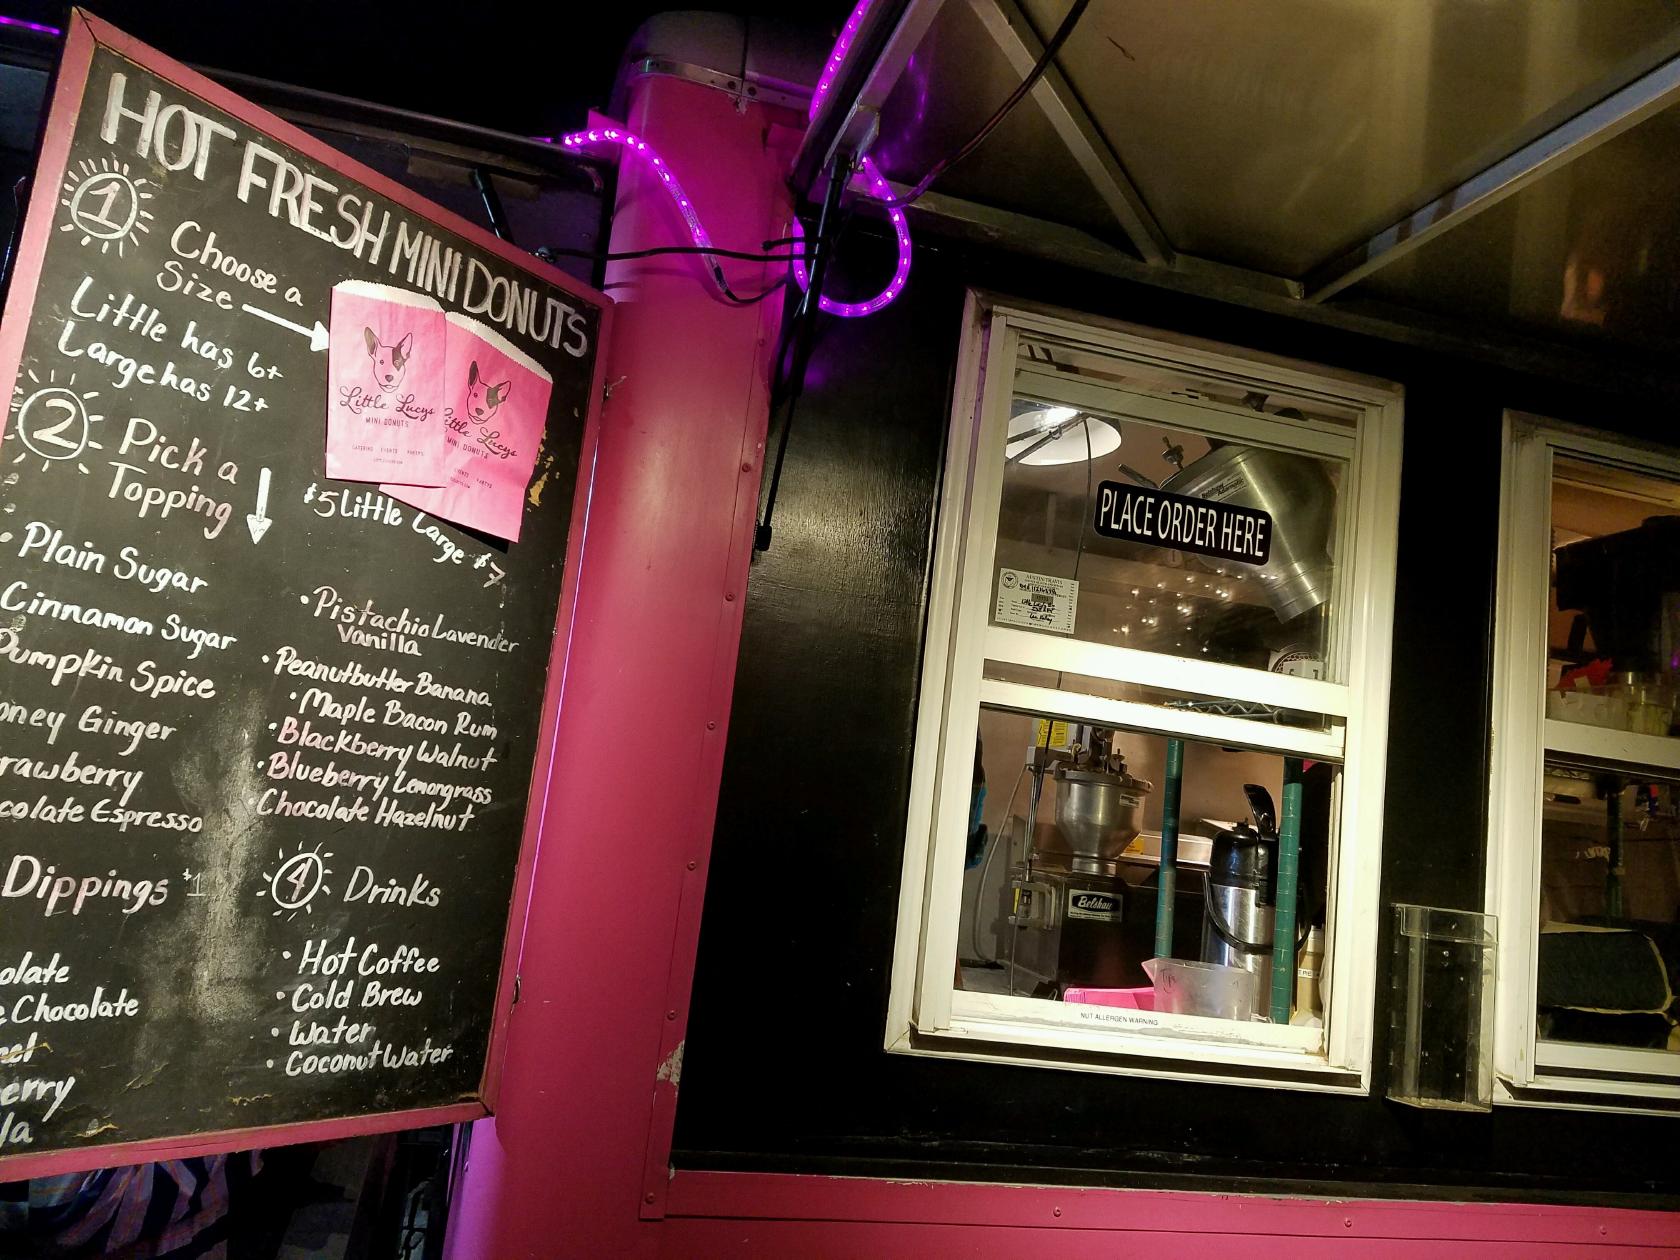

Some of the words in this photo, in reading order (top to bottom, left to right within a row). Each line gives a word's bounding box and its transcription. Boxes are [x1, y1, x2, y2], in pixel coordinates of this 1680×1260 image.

[78, 181, 122, 230] 1
[100, 72, 237, 181] HOT
[237, 140, 390, 265] FRESH
[388, 221, 463, 302] MINI
[462, 257, 588, 358] DONUTS
[156, 260, 233, 310] Size
[170, 220, 278, 294] Choose
[284, 286, 304, 307] a
[70, 276, 167, 342] Little
[181, 321, 233, 369] has
[247, 352, 284, 380] 6+
[57, 320, 155, 389] Large
[159, 361, 211, 402] has
[223, 385, 270, 412] 12+
[33, 399, 80, 449] 2
[339, 386, 389, 414] Little
[395, 394, 435, 421] Lucys
[365, 417, 381, 425] MINI
[383, 418, 409, 428] DONUTS
[119, 418, 208, 476] Pick
[217, 461, 239, 484] a
[447, 436, 460, 449] MINI
[462, 443, 489, 460] DONUTS
[477, 426, 517, 459] Lucys
[108, 462, 232, 539] Topping
[304, 483, 339, 517] $5
[340, 489, 403, 526] Little
[412, 512, 464, 563] Large
[1100, 488, 1155, 536] PLACE
[1158, 500, 1217, 548] ORDER
[1220, 512, 1266, 557] HERE
[18, 521, 105, 574] Plain
[114, 546, 208, 593] Sugar
[0, 580, 153, 636] Cinnamon
[161, 613, 237, 660] Sugar
[313, 585, 430, 639] Pistachio
[431, 613, 519, 653] Lavender
[337, 624, 422, 657] Vanilla
[129, 660, 216, 698] Spice
[414, 672, 492, 707] Banana
[78, 705, 177, 756] Ginger
[298, 687, 376, 726] Maple
[382, 700, 448, 735] Bacon
[454, 711, 497, 740] Rum
[277, 716, 414, 777] Blackberry
[416, 740, 498, 771] Walnut
[267, 751, 389, 801] Blueberry
[392, 771, 492, 811] Lemongrass
[90, 798, 203, 832] Espresso
[256, 788, 369, 822] Chocolate
[374, 796, 475, 831] Hazelnut
[1, 855, 169, 917] Dippings
[286, 857, 313, 902] 4
[343, 865, 441, 907] Drinks
[298, 936, 357, 976] Hot
[358, 943, 441, 976] Coffee
[11, 986, 139, 1023] Chocolate
[291, 979, 354, 1013] Cold
[361, 980, 423, 1007] Brew
[1095, 1013, 1128, 1023] ALLERGEN
[1128, 1016, 1159, 1026] WARNING
[289, 1015, 376, 1046] Water
[285, 1040, 382, 1077] Coconut
[383, 1038, 453, 1069] Water
